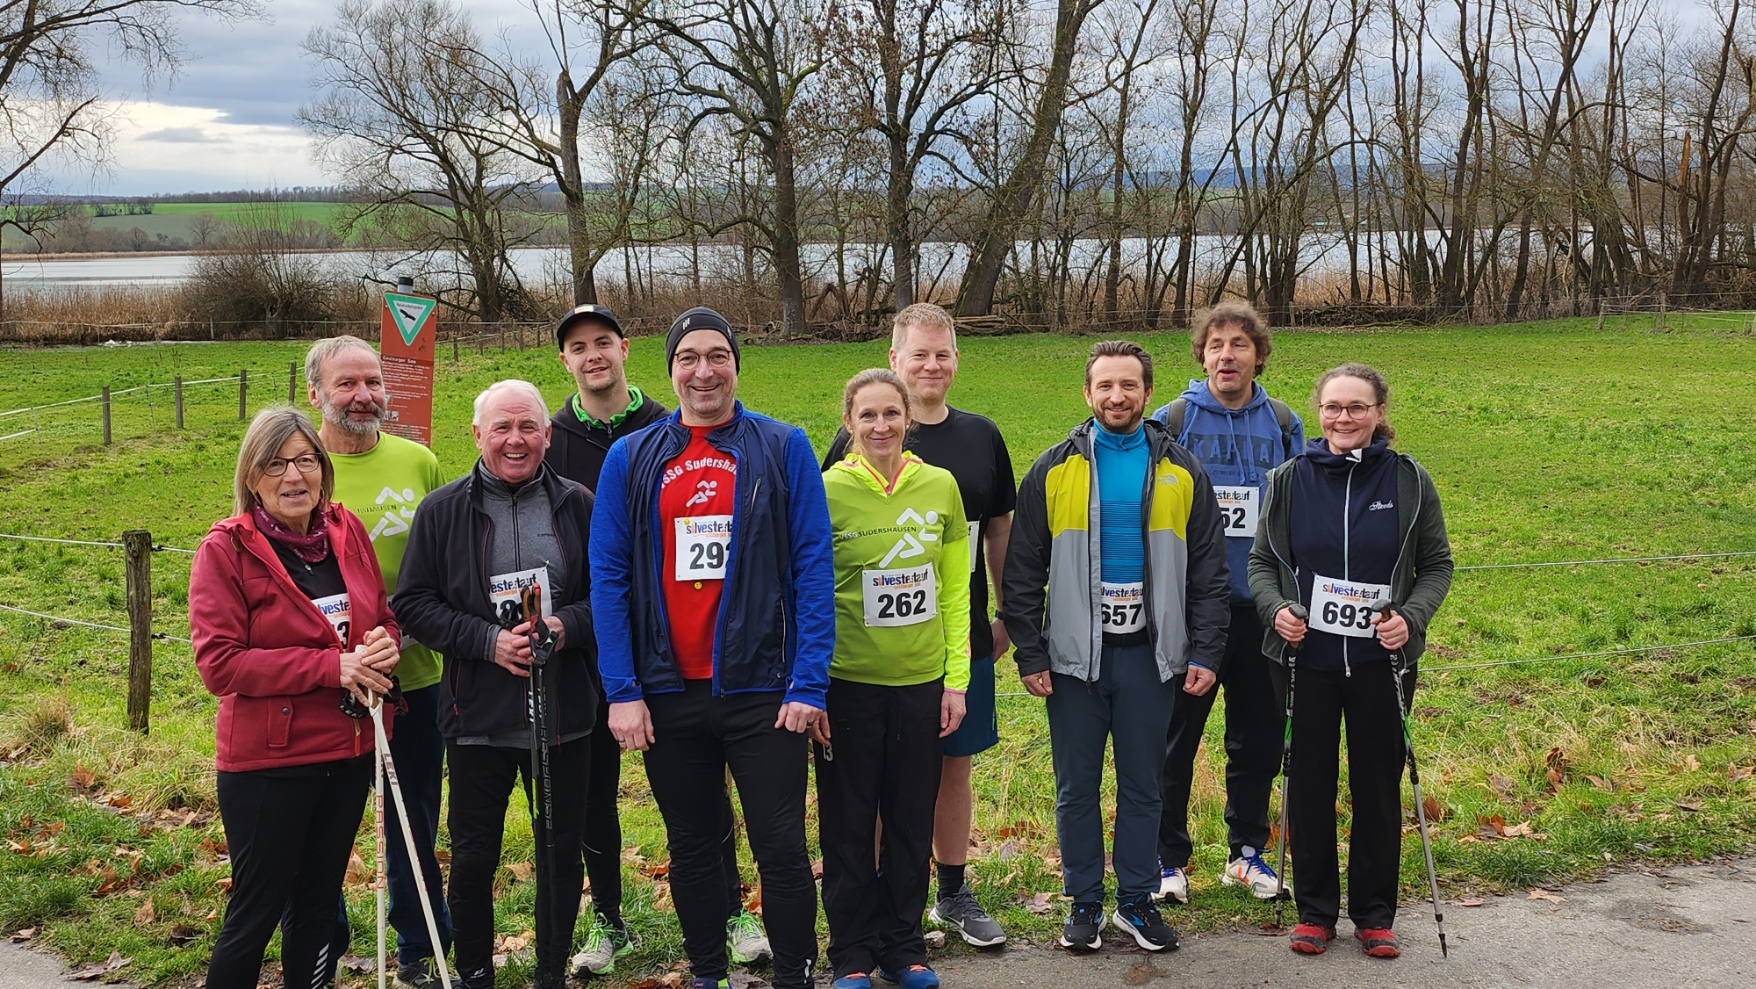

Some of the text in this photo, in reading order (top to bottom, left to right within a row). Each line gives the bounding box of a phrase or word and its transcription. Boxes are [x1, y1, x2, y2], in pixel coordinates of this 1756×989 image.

[661, 457, 737, 489] SSG Sudersha
[858, 526, 917, 538] SUDERSHAUSEN
[689, 541, 731, 570] 29
[877, 589, 926, 619] 262
[1100, 603, 1142, 626] 657
[1322, 601, 1373, 630] 693
[383, 753, 399, 786] LEKI
[376, 795, 386, 889] PASSION
